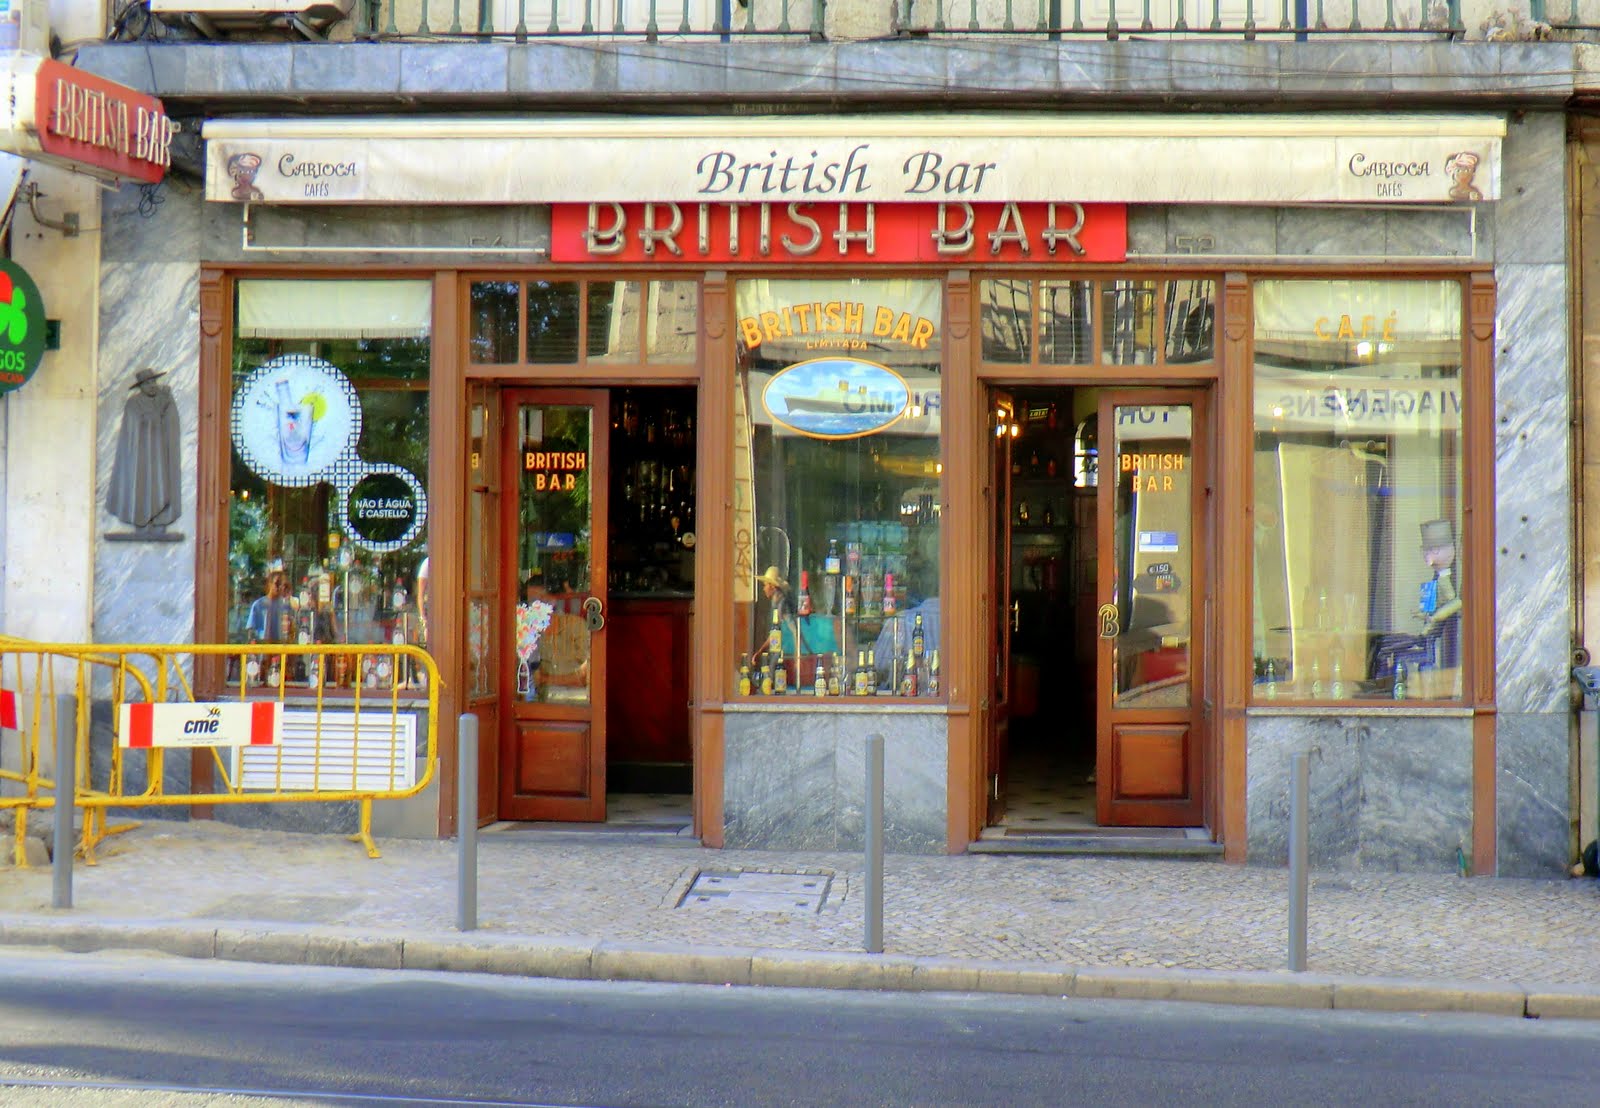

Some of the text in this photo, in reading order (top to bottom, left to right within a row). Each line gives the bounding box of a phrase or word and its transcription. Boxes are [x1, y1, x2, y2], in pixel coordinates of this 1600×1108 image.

[54, 79, 130, 153] BRITISH
[136, 107, 172, 167] BAR
[696, 144, 996, 194] British Bar
[304, 181, 330, 197] CAFÉS
[1376, 181, 1403, 197] CAFÉS
[581, 202, 1086, 255] BRITISH BAR
[739, 301, 935, 350] BRITISH BAR
[1314, 310, 1398, 342] CAFÉ
[526, 452, 586, 470] BRITISH
[1121, 454, 1184, 472] BRITISH
[536, 473, 577, 491] BAR
[1132, 475, 1173, 492] BAR
[355, 498, 376, 509] NÃO
[378, 497, 384, 509] É
[183, 718, 220, 734] cme
